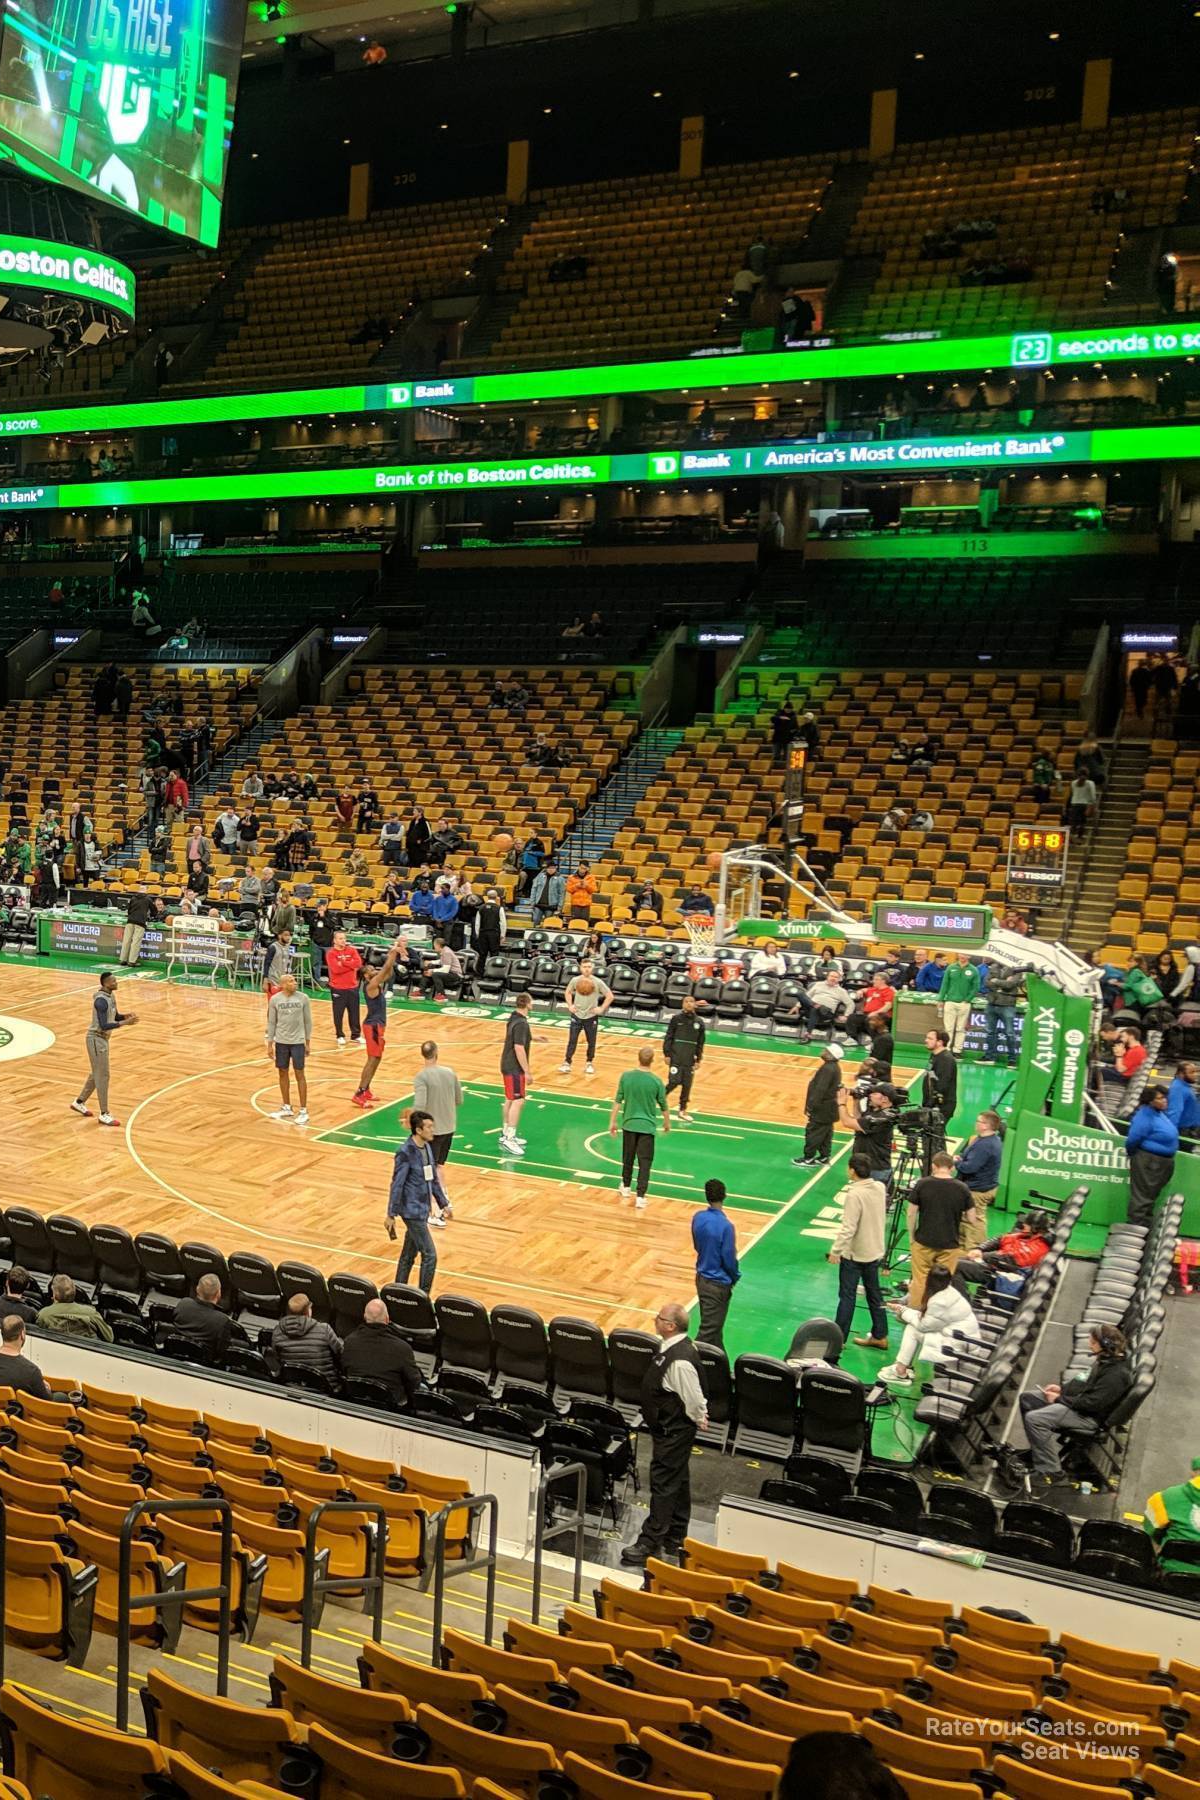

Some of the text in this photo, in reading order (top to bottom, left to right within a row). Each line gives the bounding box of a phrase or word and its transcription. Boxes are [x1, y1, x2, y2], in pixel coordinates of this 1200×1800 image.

[73, 257, 129, 300] Celtics.
[1020, 340, 1045, 359] 23
[1058, 335, 1149, 355] seconds
[1153, 334, 1178, 349] to
[390, 384, 455, 401] TD Bank
[6, 419, 41, 430] score.
[653, 457, 676, 474] TD
[683, 454, 730, 468] Bank
[764, 448, 845, 466] America's
[850, 445, 895, 462] Most
[898, 440, 1001, 461] Convenient
[375, 464, 596, 487] Bank of the Boston Celtics.
[963, 540, 987, 551] 113
[1024, 871, 1062, 881] TISSOT
[778, 922, 821, 938] xfinity
[887, 912, 973, 929] Exxon Mobil
[74, 944, 98, 952] ENGLAND
[986, 944, 1024, 966] SPALDING
[1031, 1006, 1060, 1073] xfinity
[1061, 1047, 1080, 1104] Putnam
[1043, 1127, 1113, 1152] Boston
[1019, 1165, 1124, 1184] Advancing science for
